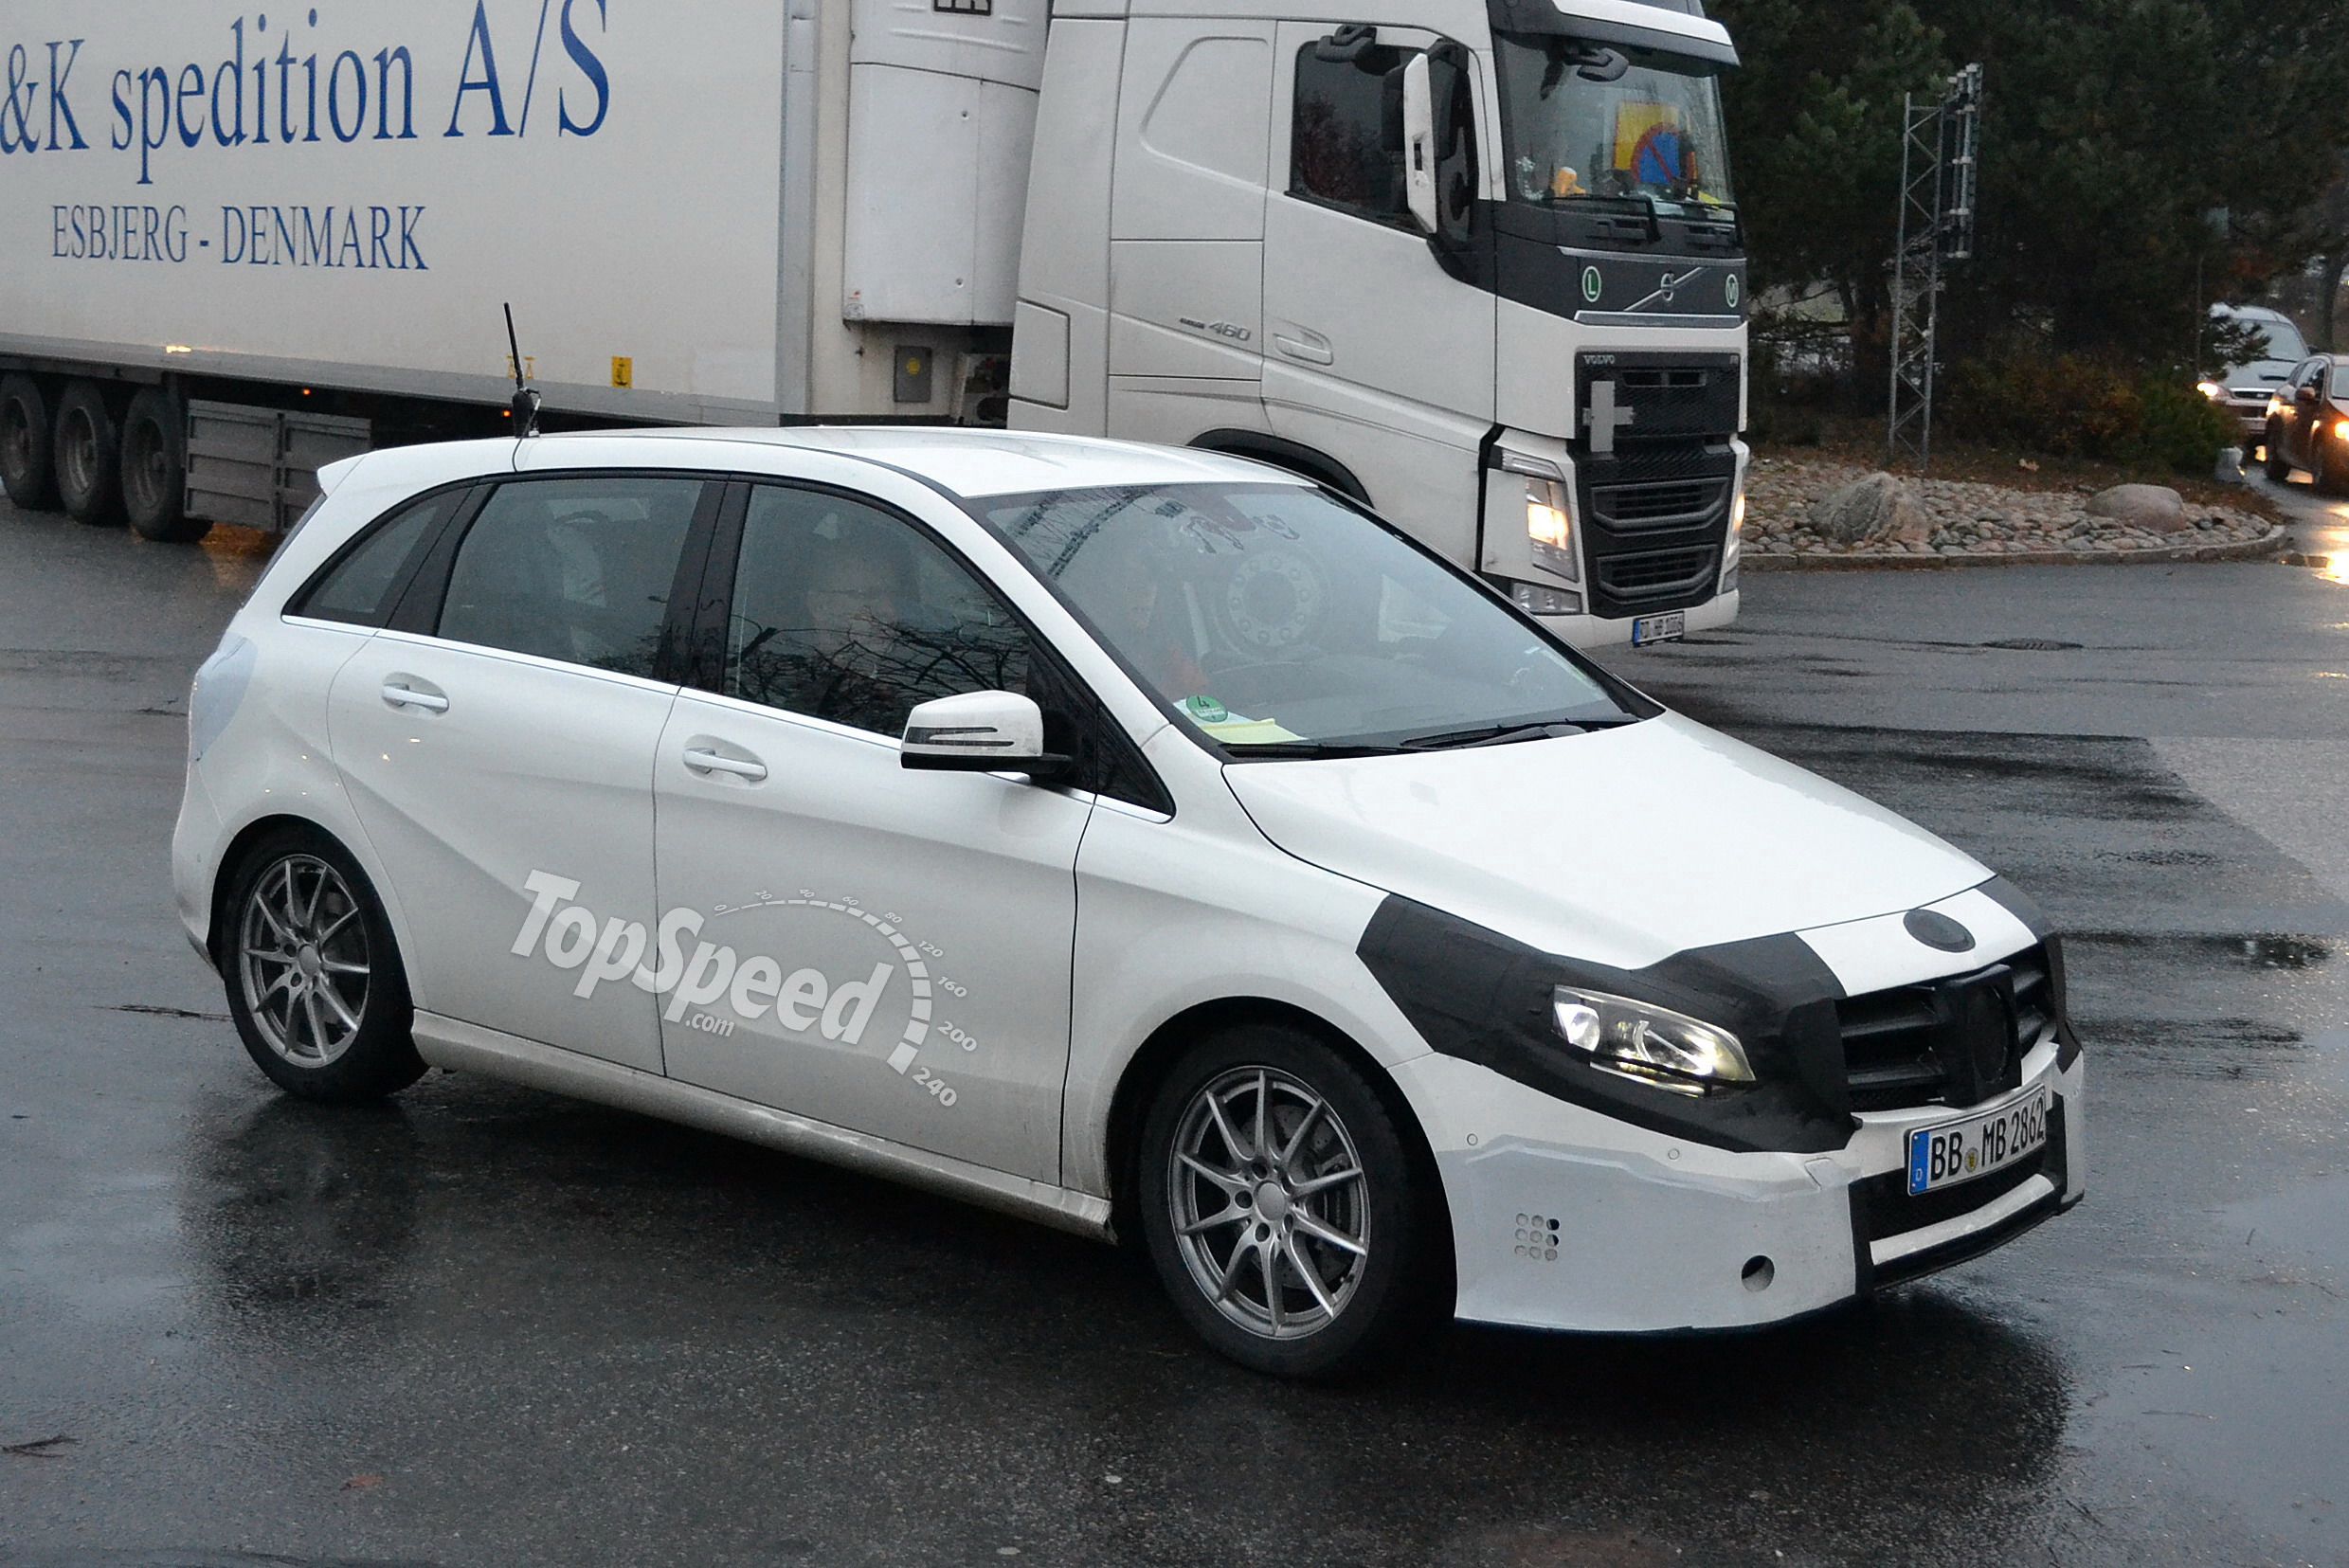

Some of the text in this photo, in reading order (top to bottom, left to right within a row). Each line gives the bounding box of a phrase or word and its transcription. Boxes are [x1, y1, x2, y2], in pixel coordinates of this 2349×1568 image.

[111, 9, 419, 185] spedition
[443, 0, 610, 137] A/S
[52, 205, 189, 262] ESBJERG
[220, 206, 429, 270] DENMARK
[1209, 320, 1252, 342] 460
[1930, 1131, 1964, 1181] BB
[1981, 1116, 2008, 1167] MB
[2011, 1096, 2045, 1154] 2862
